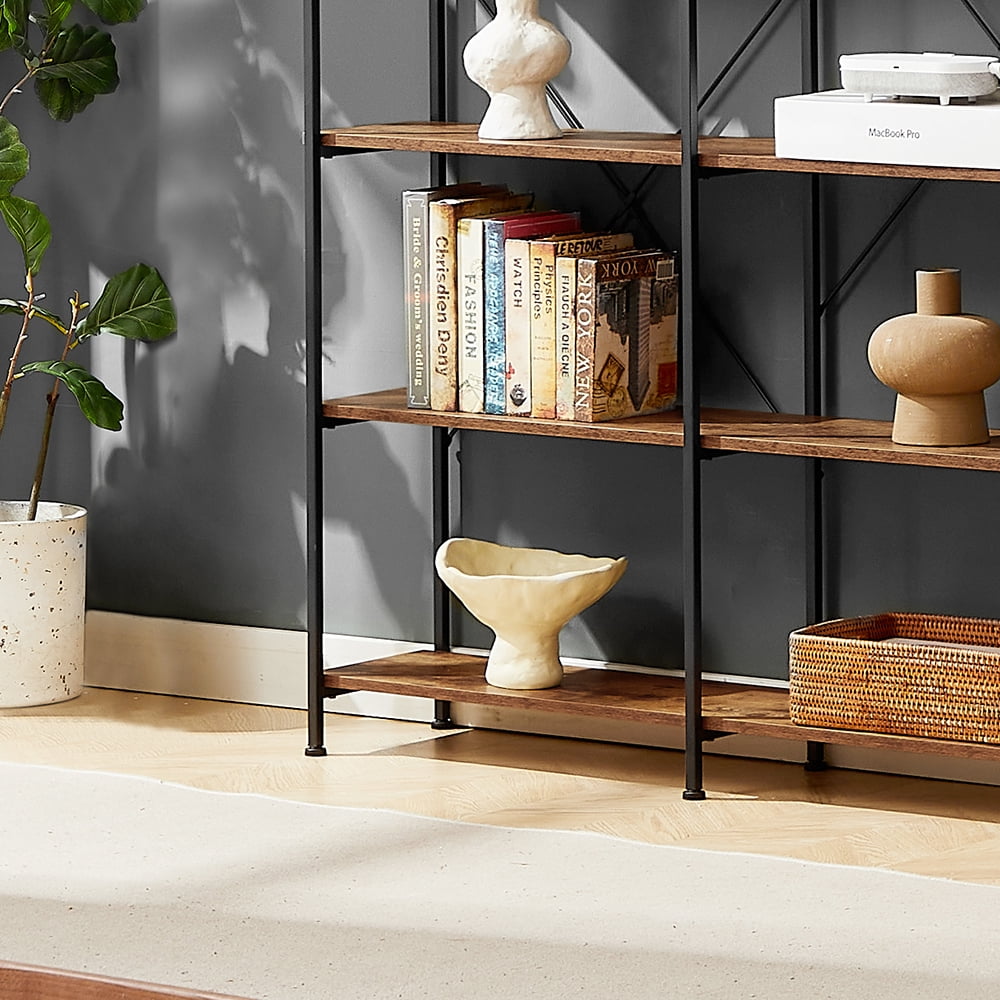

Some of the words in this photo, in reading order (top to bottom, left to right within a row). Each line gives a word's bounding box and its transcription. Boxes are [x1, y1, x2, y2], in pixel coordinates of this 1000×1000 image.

[868, 127, 906, 138] MacBook
[906, 129, 921, 139] Pro
[412, 217, 421, 254] Bride
[567, 239, 603, 255] RETOUR
[413, 256, 422, 269] &
[435, 235, 450, 323] Chrisdien
[513, 257, 523, 308] WATCH
[532, 257, 543, 320] Principles
[543, 264, 554, 314] Physics
[413, 272, 423, 330] Groom's
[464, 274, 477, 358] FASHION
[577, 273, 593, 340] YORK
[414, 332, 424, 387] wedding
[434, 329, 451, 377] Deny
[574, 351, 592, 409] NEW
